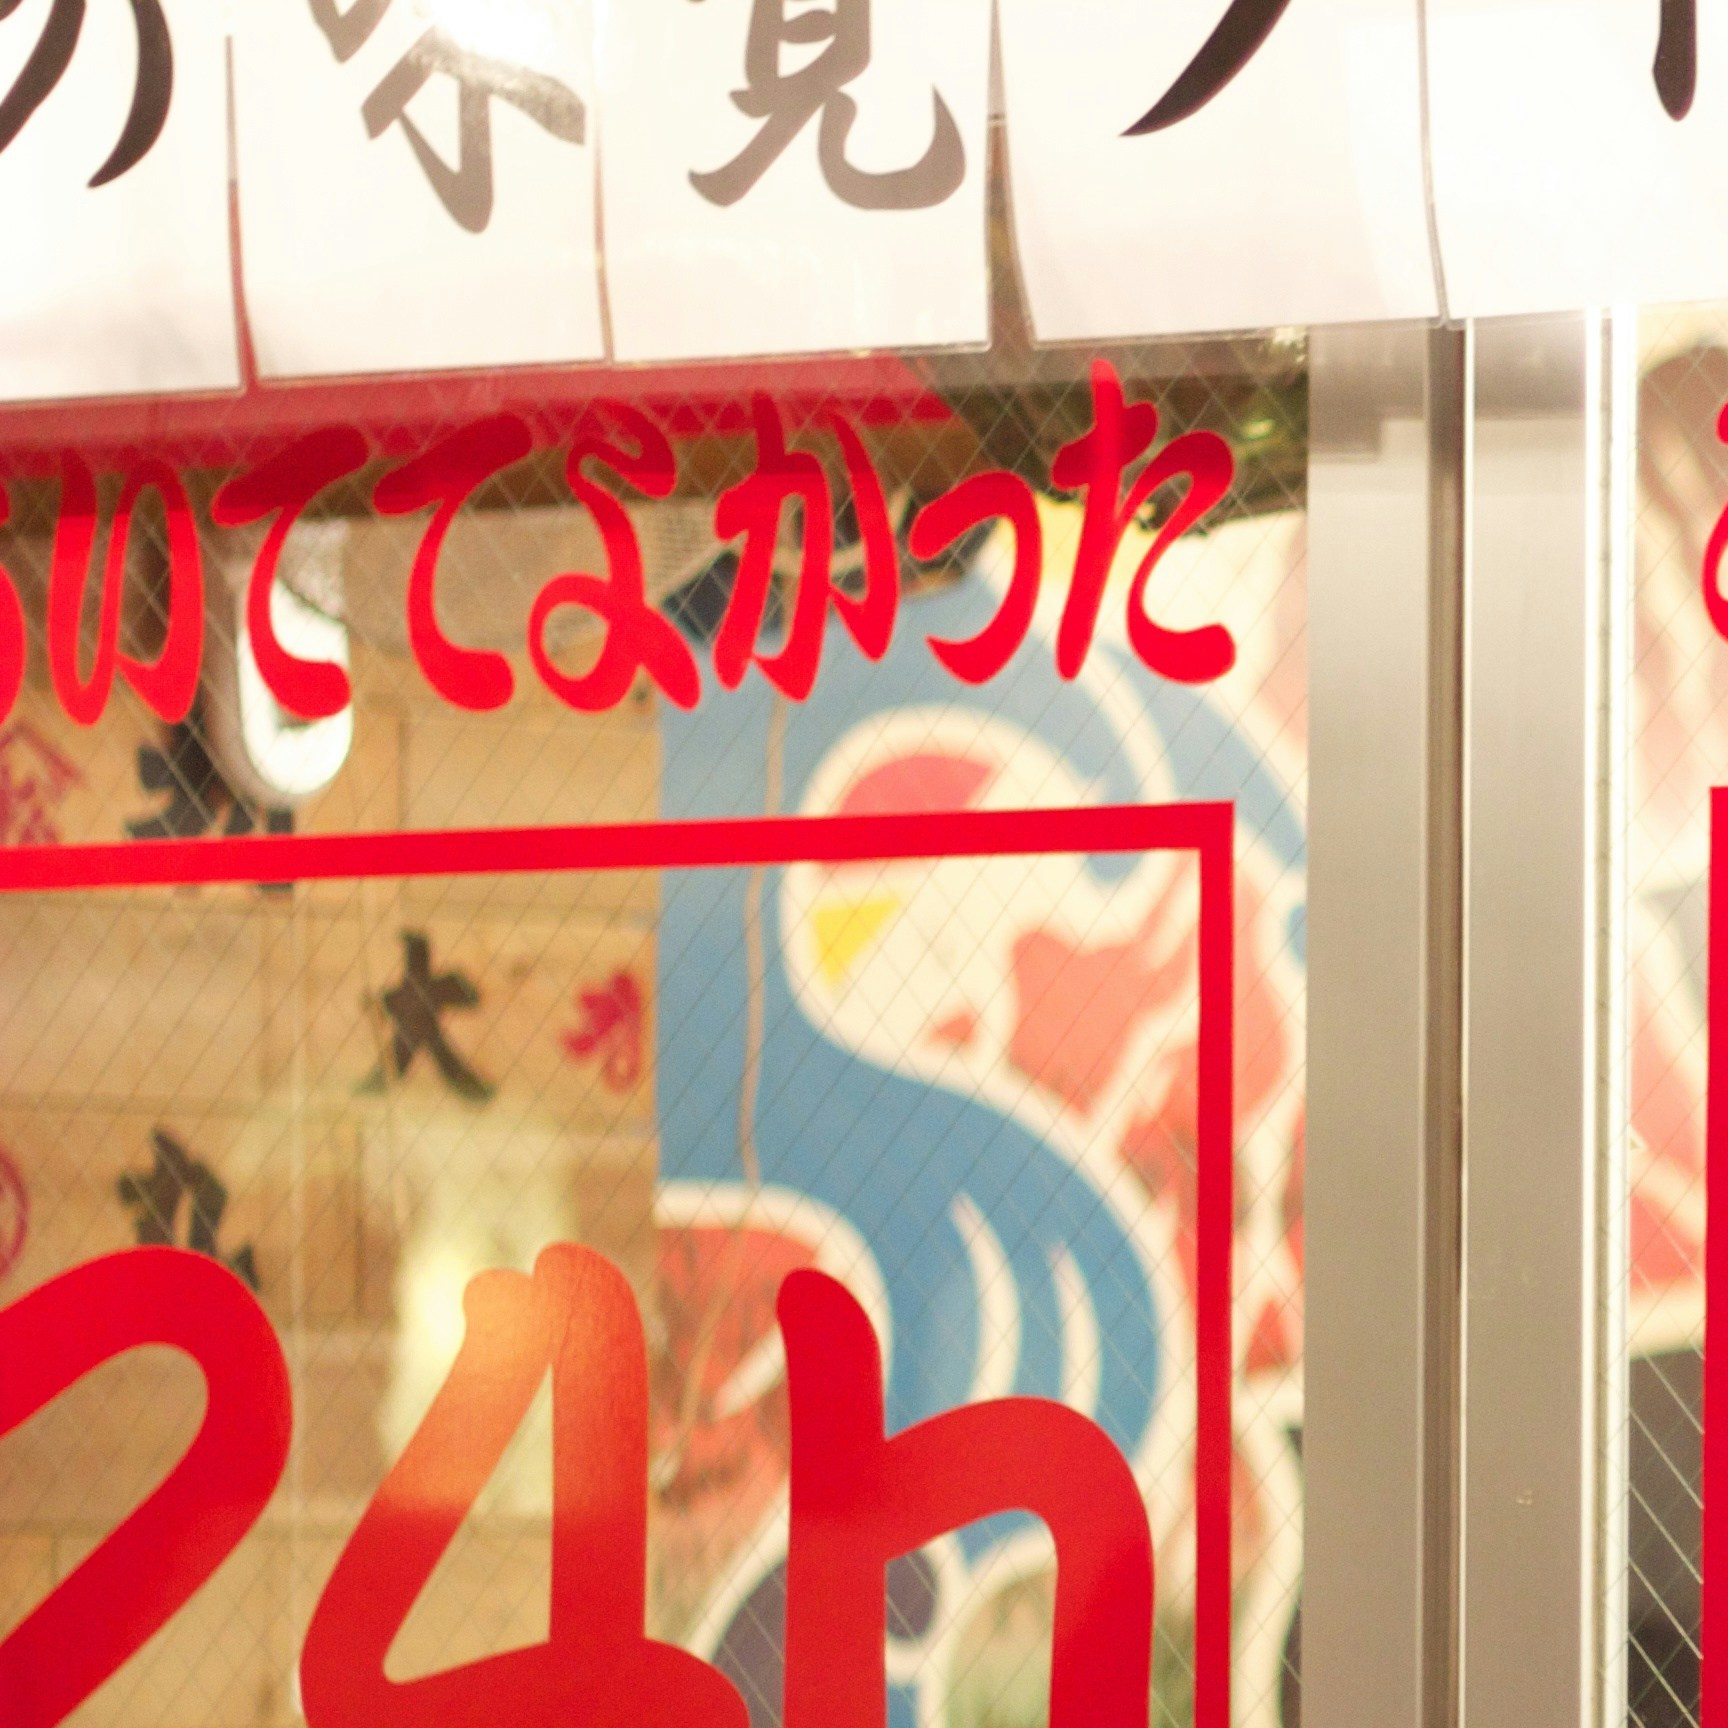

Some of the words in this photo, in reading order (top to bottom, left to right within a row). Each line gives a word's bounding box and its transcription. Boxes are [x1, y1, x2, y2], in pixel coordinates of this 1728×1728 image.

[0, 357, 1237, 728] いててよかった
